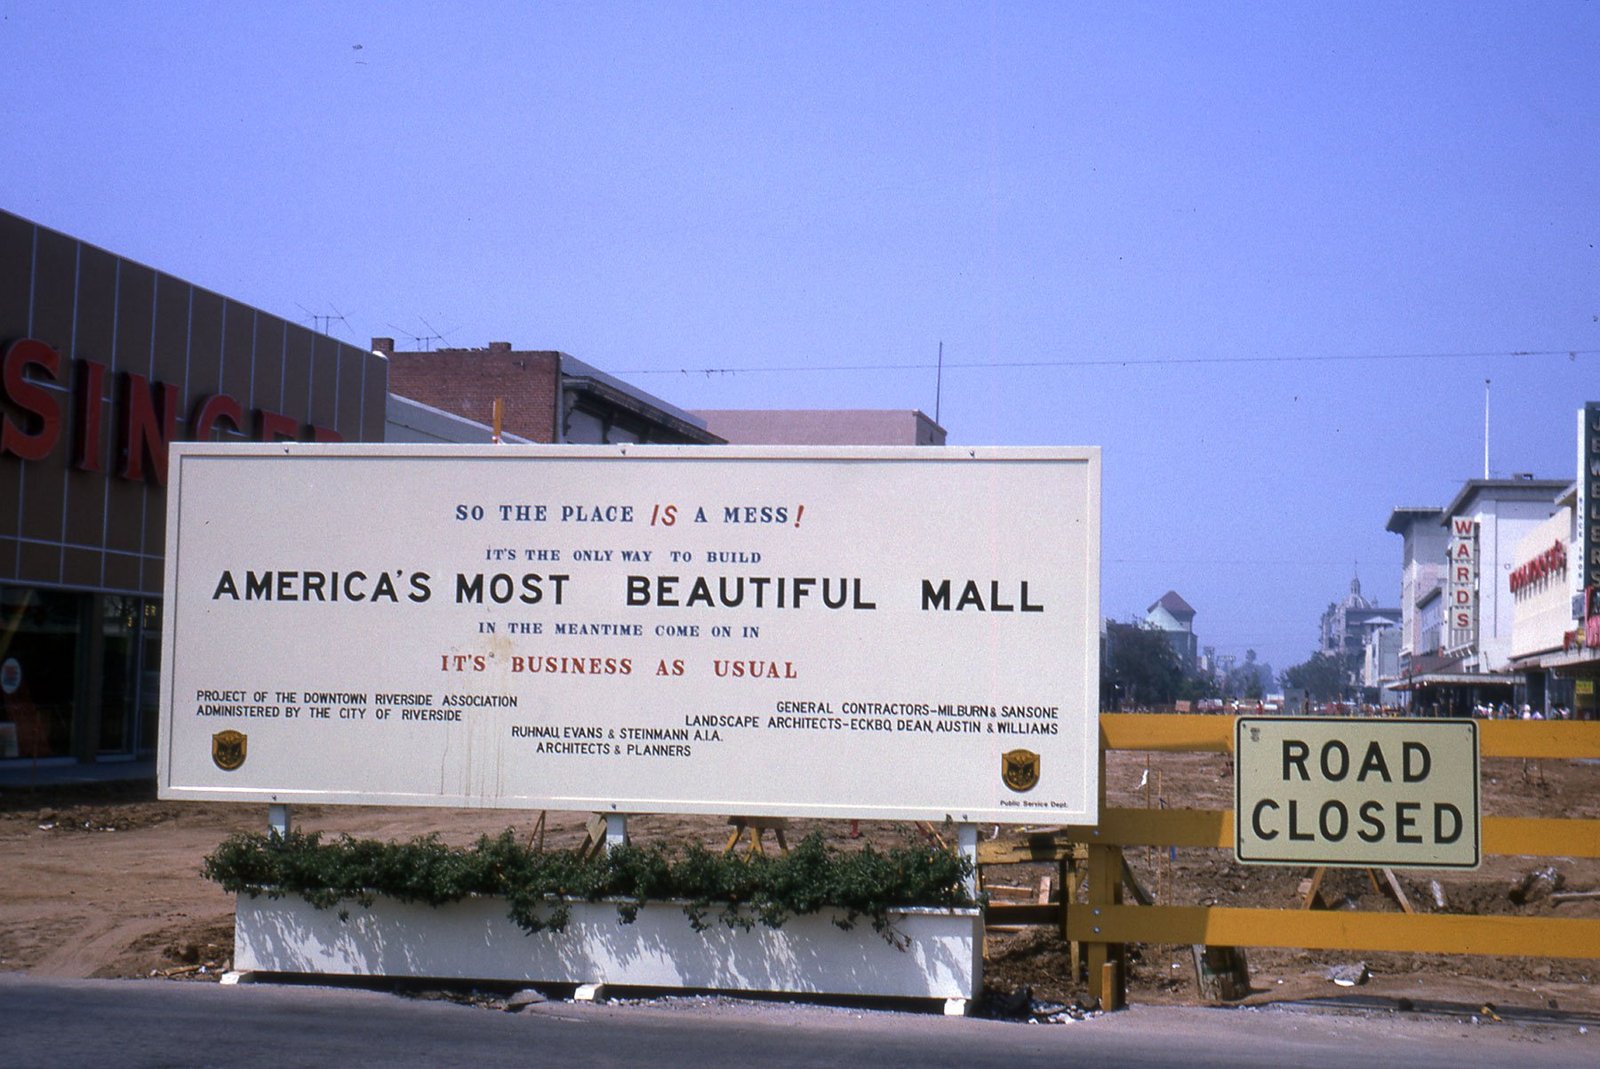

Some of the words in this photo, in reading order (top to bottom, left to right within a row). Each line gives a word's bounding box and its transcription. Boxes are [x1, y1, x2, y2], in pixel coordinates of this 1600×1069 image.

[455, 504, 485, 521] SO
[499, 505, 546, 521] THE
[562, 506, 633, 522] PLACE
[651, 504, 677, 526] IS
[694, 506, 708, 523] A
[485, 547, 517, 561] IT'S
[524, 549, 561, 562] THE
[572, 549, 614, 562] ONLY
[620, 550, 653, 562] WAY
[669, 550, 692, 563] TO
[706, 551, 762, 564] BUILD
[1455, 520, 1473, 628] WARDS
[212, 570, 431, 603] AMERICA'S
[456, 573, 569, 605] MOST
[627, 575, 876, 610] BEAUTIFUL
[922, 579, 1044, 612] MALL
[478, 621, 496, 634] IN
[507, 622, 543, 635] THE
[554, 623, 643, 637] MEANTIME
[654, 624, 700, 638] COME
[711, 625, 732, 638] ON
[742, 626, 760, 639] IN
[442, 654, 485, 671] IT'S
[512, 656, 632, 675] BUSINESS
[656, 659, 684, 676] AS
[714, 660, 797, 678] USUAL
[196, 689, 247, 703] PROJECT
[253, 690, 269, 704] OF
[274, 691, 297, 704] THE
[303, 691, 368, 705] DOWNTOWN
[374, 693, 433, 707] RIVERSIDE
[441, 694, 518, 708] ASSOCIATION
[196, 703, 281, 718] ADMINISTERED
[284, 706, 302, 719] BY
[308, 706, 332, 719] THE
[339, 707, 367, 720] CITY
[375, 707, 392, 720] OF
[401, 708, 463, 722] RIVERSIDE
[776, 700, 834, 715] GENERAL
[1000, 705, 1059, 720] SANSONE
[563, 726, 603, 740] EVANS
[618, 727, 689, 741] STEINMANN
[693, 728, 724, 742] A.I.A.
[685, 714, 760, 729] LANDSCAPE
[937, 719, 982, 734] AUSTIN
[996, 721, 1059, 736] WILLIAMS
[535, 741, 611, 756] ARCHITECTS
[626, 743, 692, 758] PLANNERS
[1283, 740, 1431, 782] ROAD
[1253, 798, 1462, 843] CLOSED
